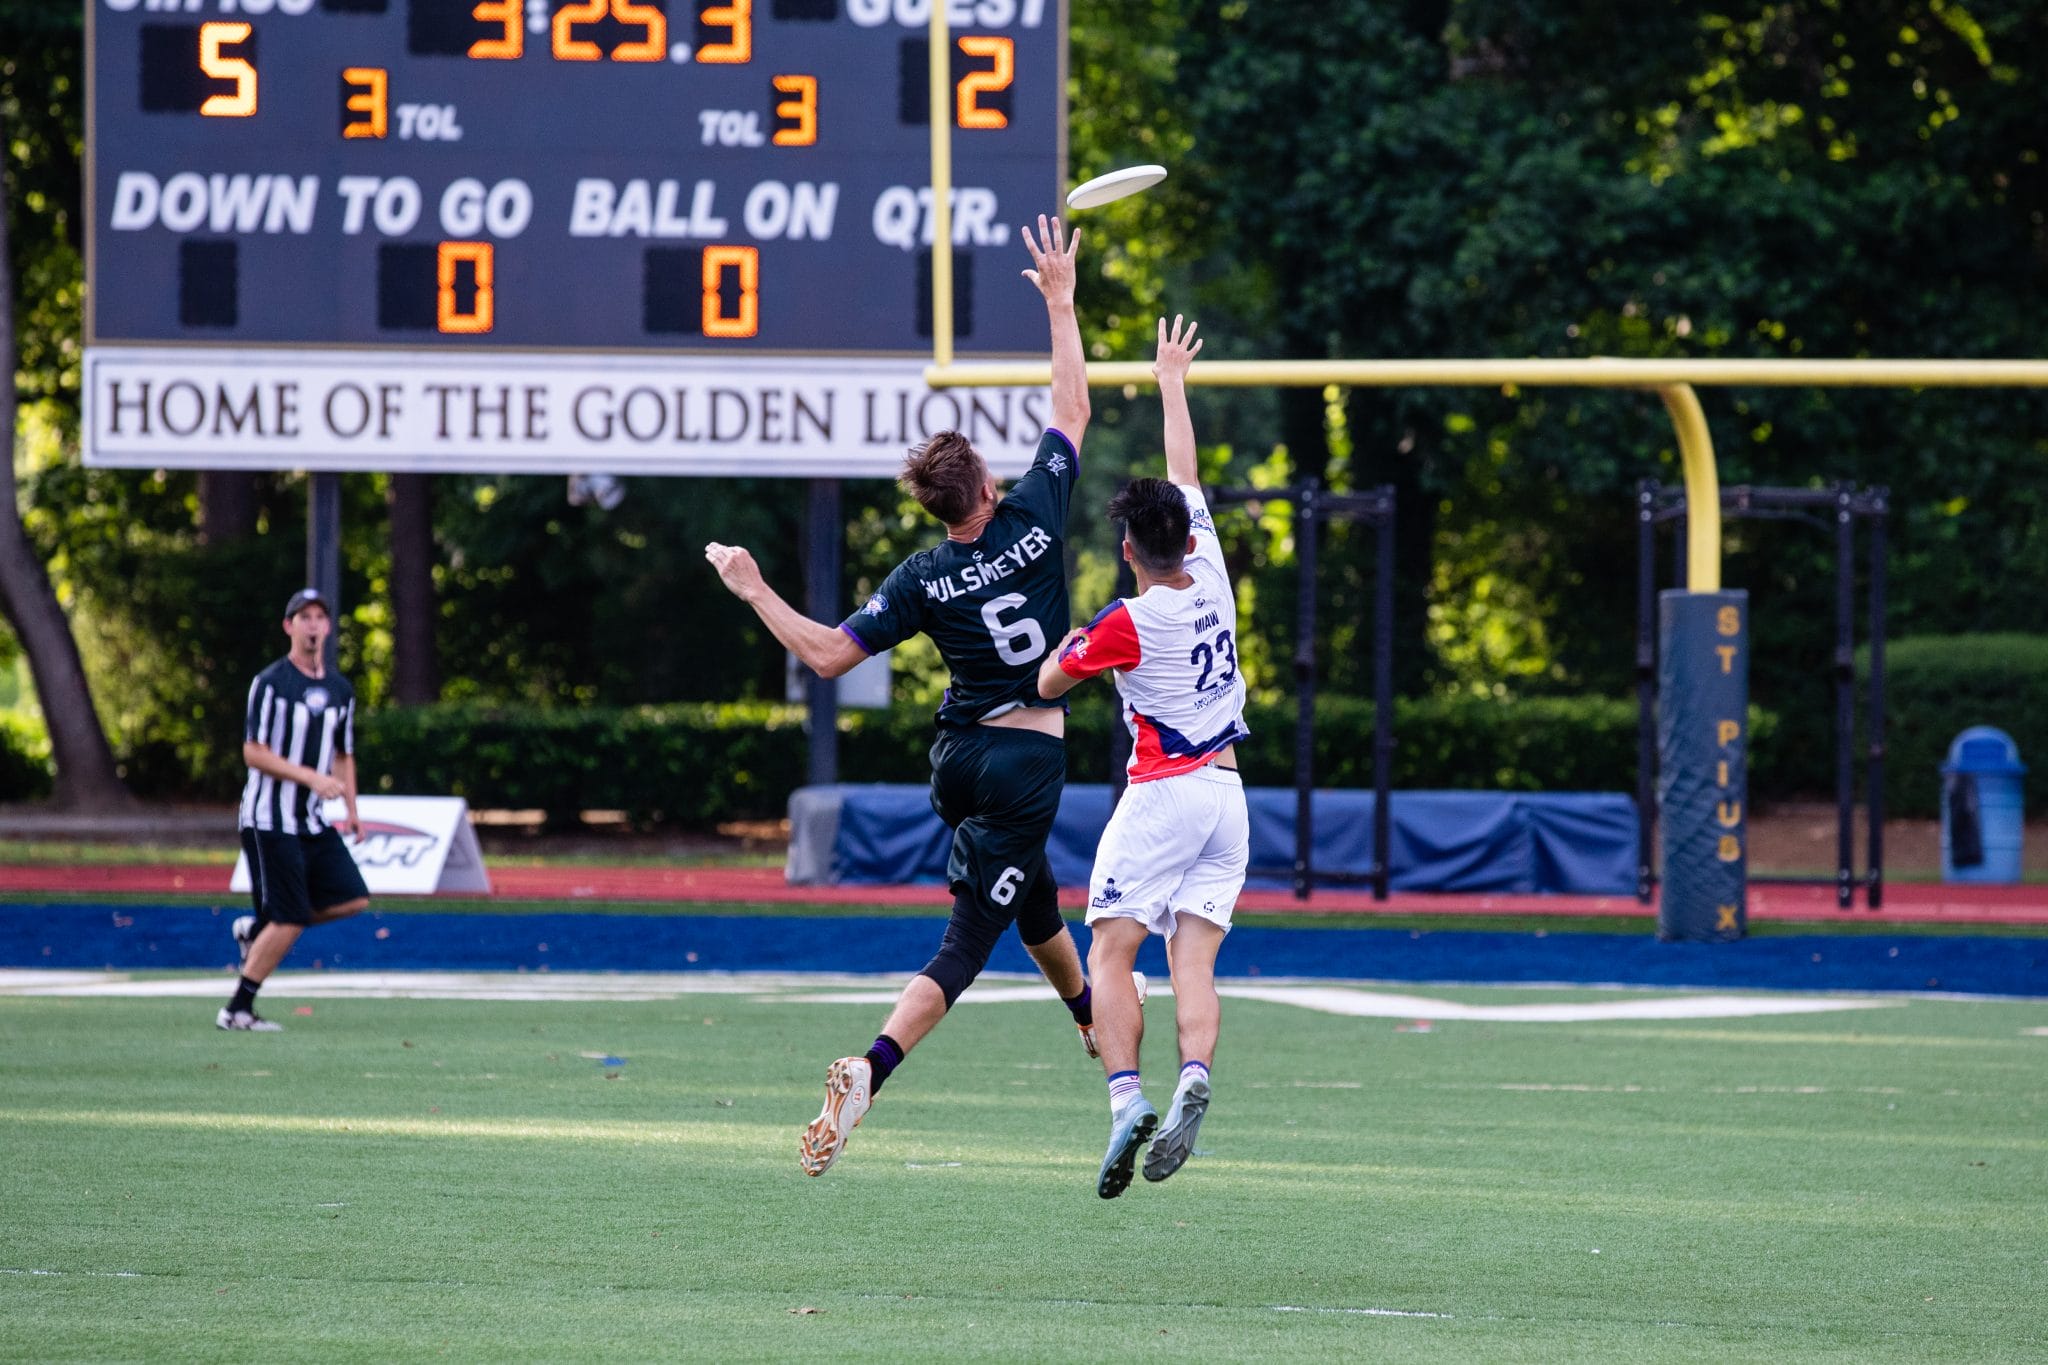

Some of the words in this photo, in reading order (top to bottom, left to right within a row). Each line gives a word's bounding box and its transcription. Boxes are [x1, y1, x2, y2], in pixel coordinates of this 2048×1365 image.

[199, 22, 257, 117] 5
[956, 36, 1015, 129] 2
[342, 67, 387, 139] 3
[397, 104, 463, 141] TOL
[699, 110, 765, 147] TOL
[771, 75, 817, 146] 3
[110, 171, 320, 233] DOWN
[337, 176, 422, 236] TO
[439, 178, 534, 239] GO
[568, 178, 729, 239] BALL
[743, 181, 839, 241] ON
[437, 241, 494, 334] 0
[702, 245, 759, 338] 0
[107, 379, 300, 438] HOME
[323, 382, 405, 439] OF
[423, 384, 549, 441] THE
[573, 384, 837, 444] GOLDEN
[864, 389, 1045, 446] LIONS
[980, 592, 1047, 666] 6
[1195, 610, 1219, 635] MIAW
[1191, 629, 1236, 692] 23
[990, 866, 1025, 906] 6
